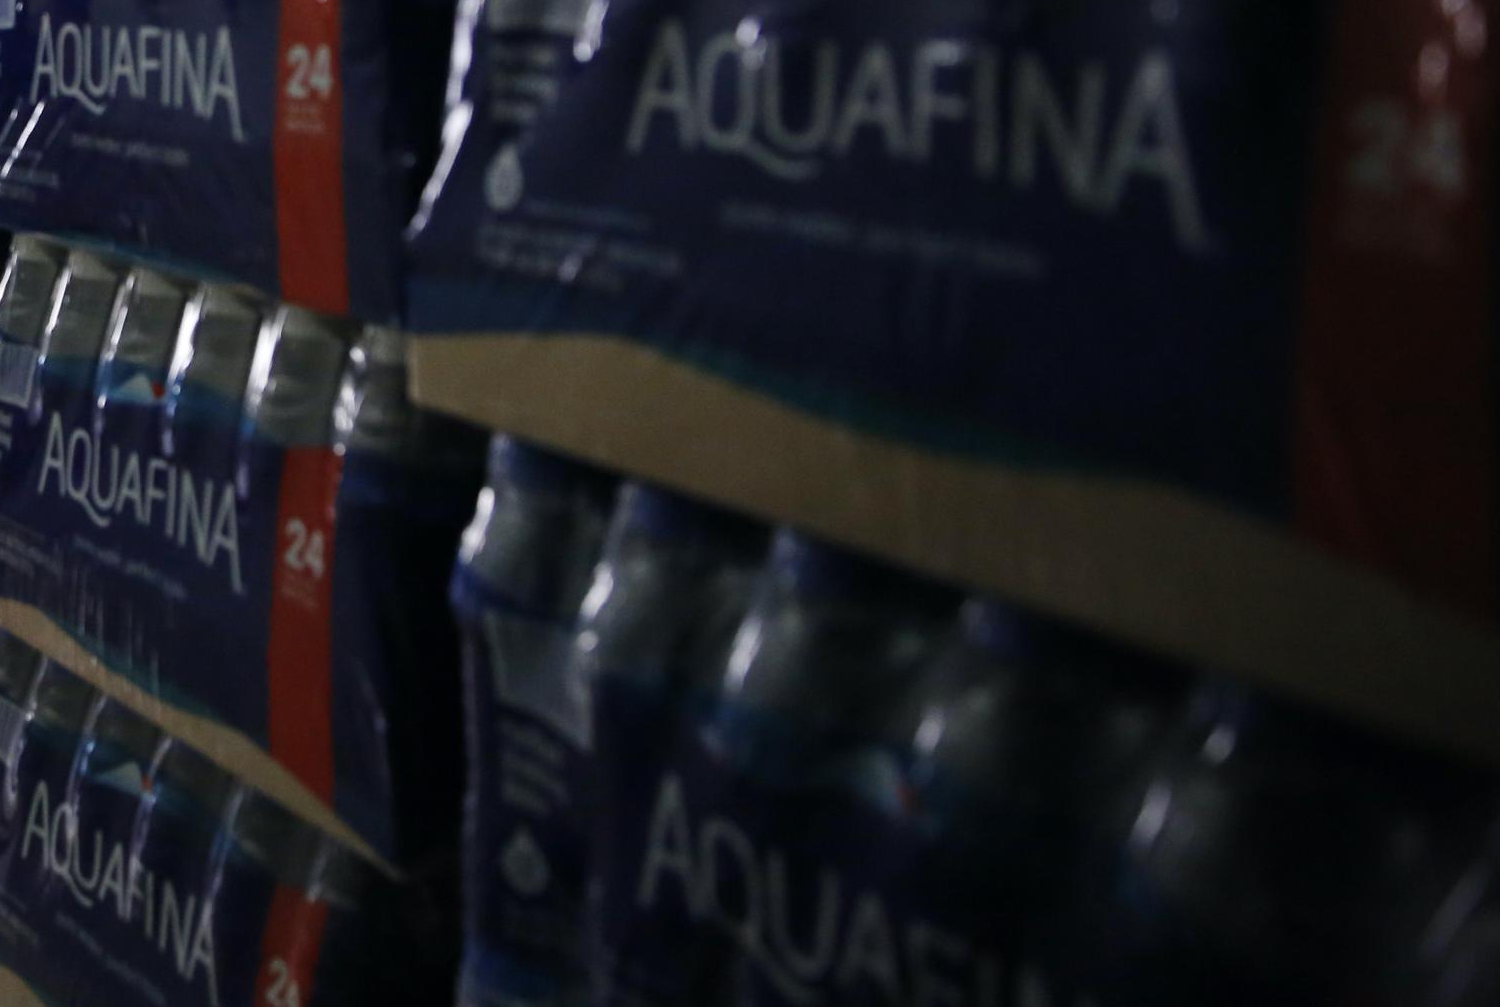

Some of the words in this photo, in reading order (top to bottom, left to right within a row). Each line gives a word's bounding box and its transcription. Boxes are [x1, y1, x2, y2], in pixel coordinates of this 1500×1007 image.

[30, 11, 247, 143] AQUAFINA
[287, 43, 333, 100] 24
[626, 16, 1214, 259] AQUAFINA
[37, 411, 243, 594] AQUAFINA
[285, 518, 324, 578] 24
[21, 780, 220, 1007] AQUAFINA
